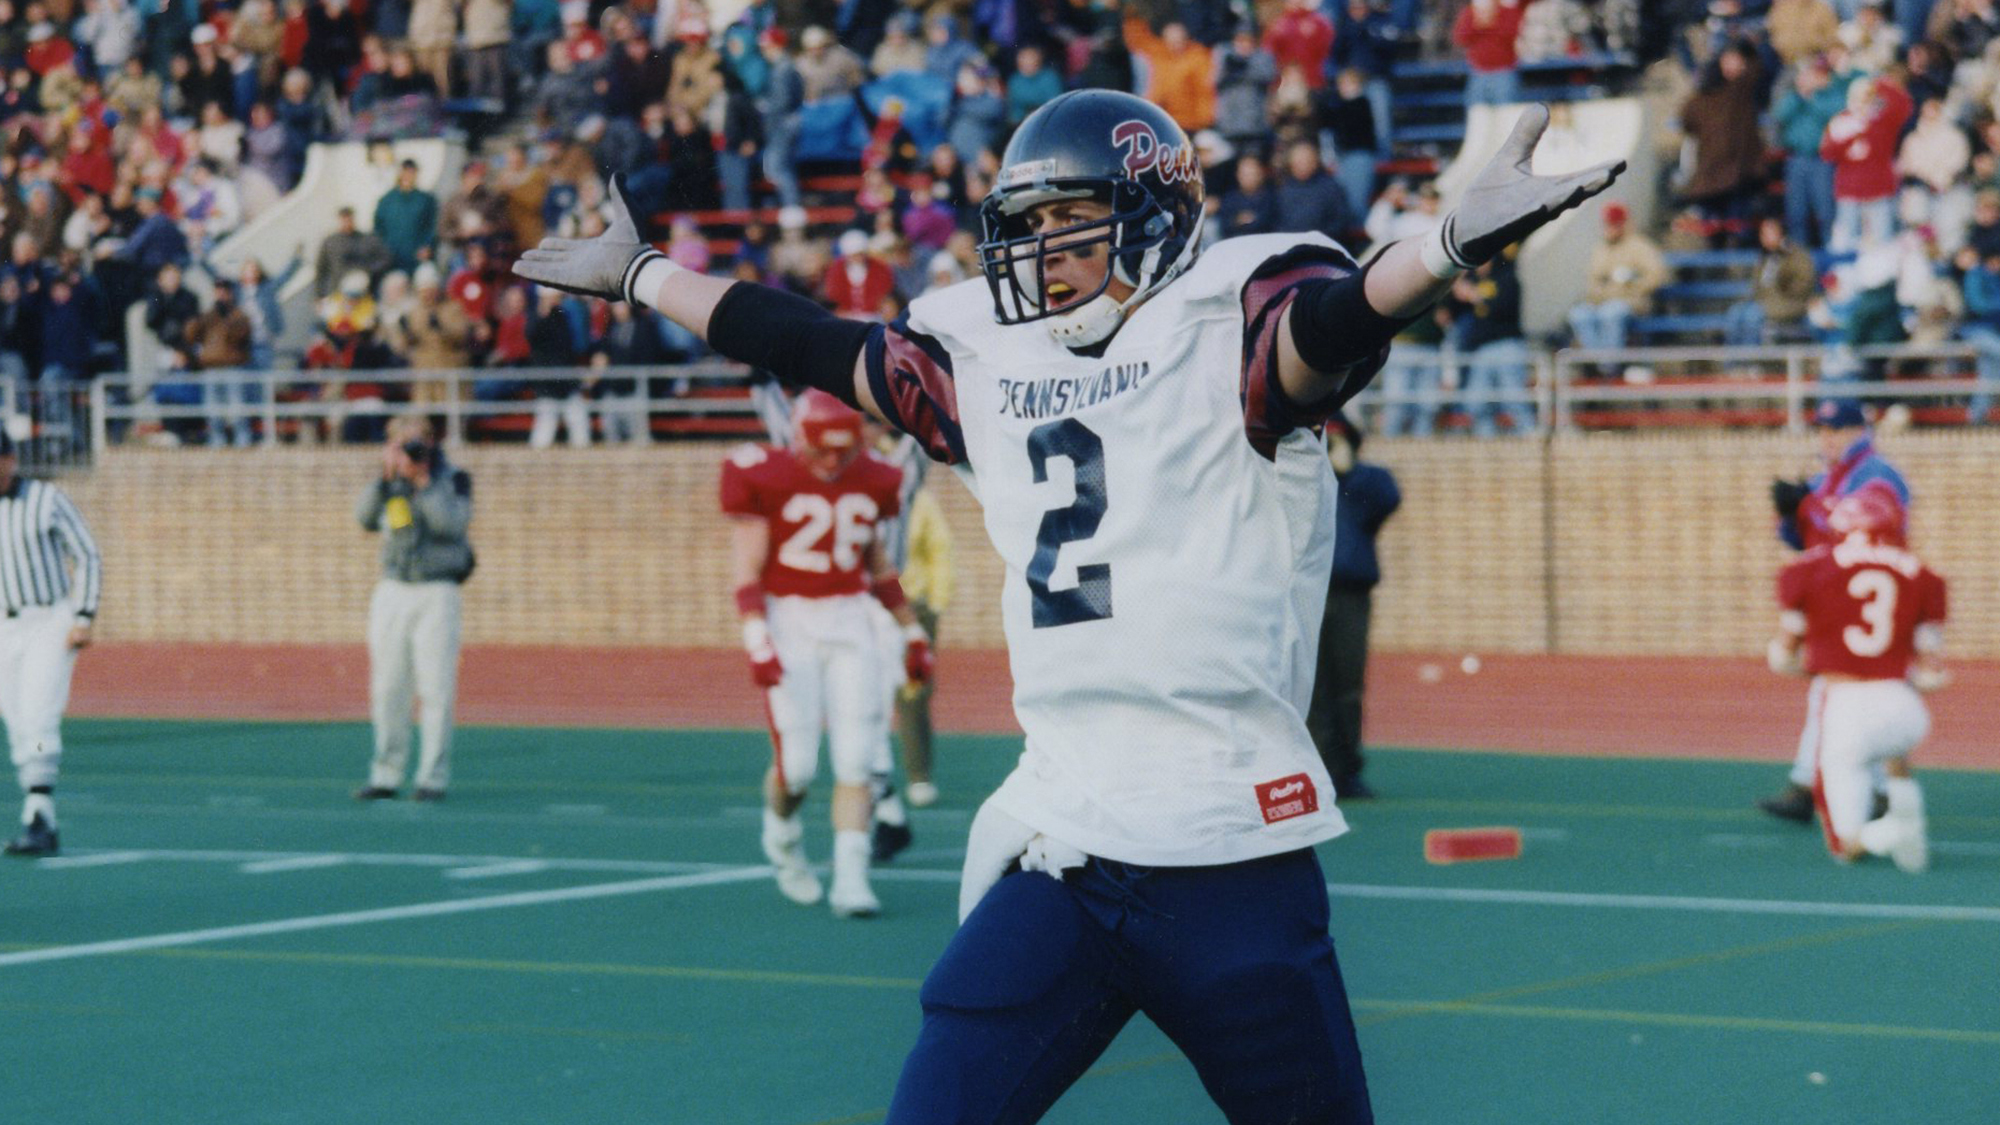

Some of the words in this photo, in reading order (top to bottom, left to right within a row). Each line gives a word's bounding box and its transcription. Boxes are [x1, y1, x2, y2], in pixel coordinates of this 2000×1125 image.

[778, 493, 879, 573] 26
[1026, 417, 1113, 629] 2
[1843, 568, 1898, 657] 3
